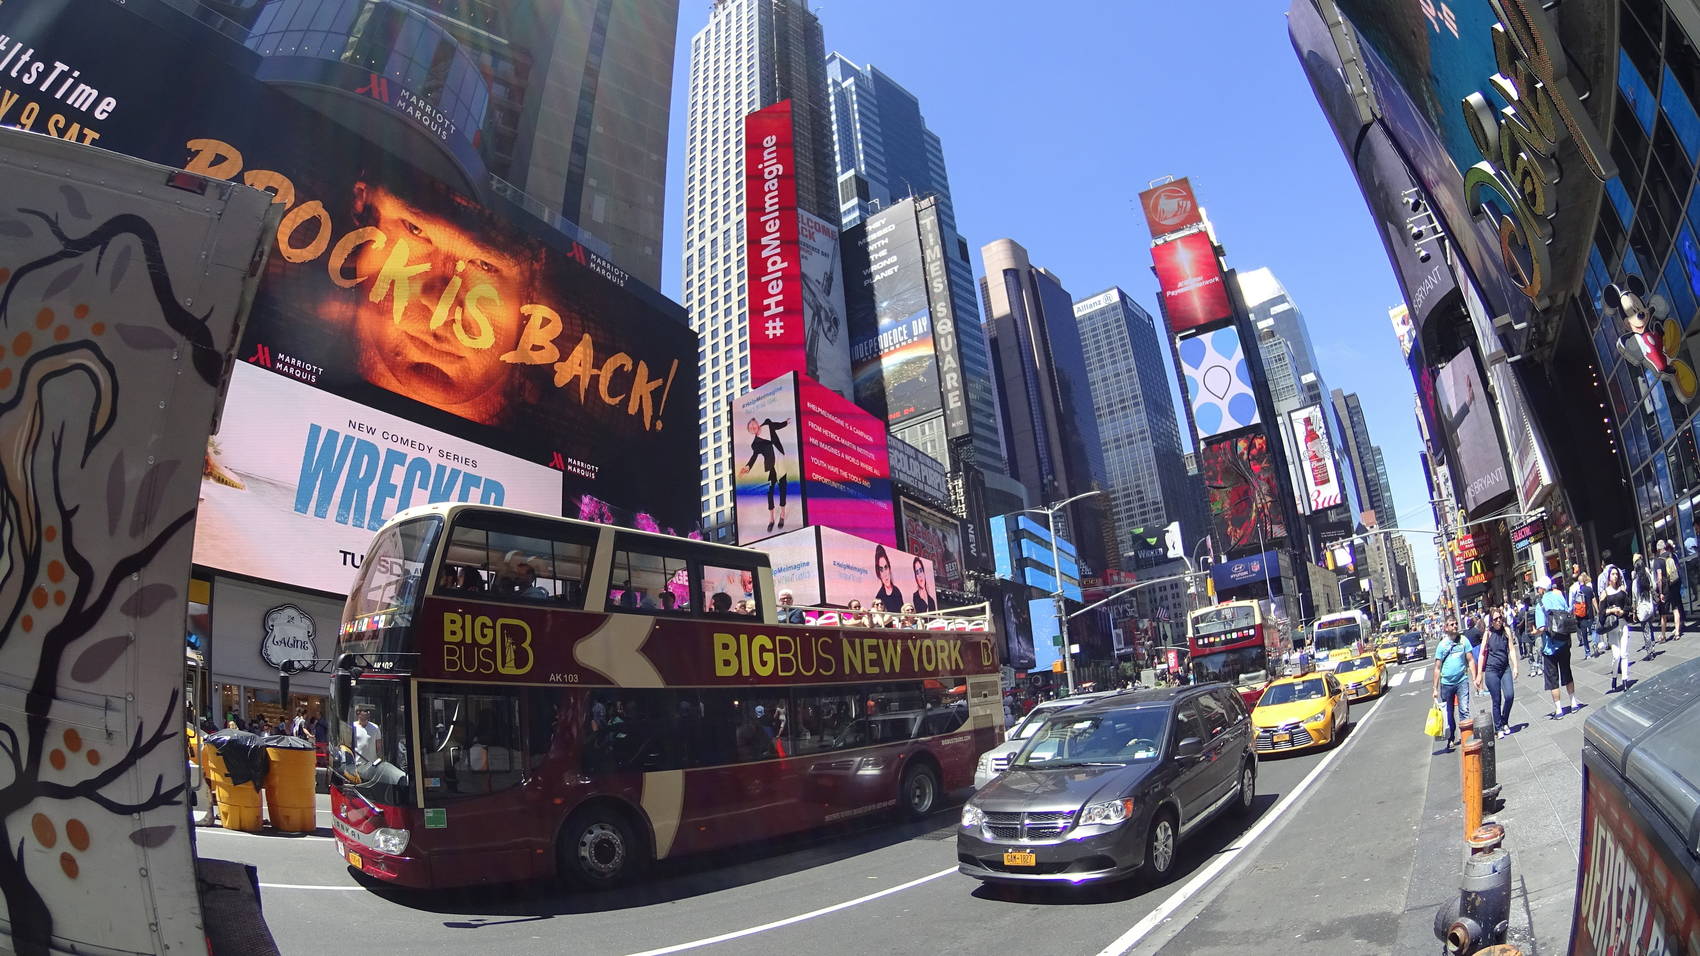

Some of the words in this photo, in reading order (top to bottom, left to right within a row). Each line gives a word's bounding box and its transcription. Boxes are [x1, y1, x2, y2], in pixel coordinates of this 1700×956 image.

[396, 100, 448, 140] MARQUIS
[400, 89, 456, 134] MARRIOTT
[590, 253, 630, 280] MARRIOTT
[862, 255, 898, 276] WRONG
[869, 249, 888, 261] THE
[589, 262, 625, 287] MARQUIS
[920, 216, 944, 293] TIMES
[936, 302, 962, 409] SQUARE
[1076, 300, 1102, 314] Allianz
[912, 316, 928, 336] DAY
[276, 363, 317, 383] MARQUIS
[277, 353, 324, 375] MARRIOTT
[500, 304, 679, 431] BACK!
[348, 419, 377, 437] NEW
[381, 430, 434, 455] COMEDY
[437, 448, 480, 469] SERIES
[567, 457, 599, 473] MARRIOTT
[567, 465, 596, 480] MARQUIS
[967, 523, 978, 557] NEW
[443, 612, 494, 646] BIG
[443, 645, 495, 675] BUS
[842, 637, 901, 674] NEW
[909, 639, 965, 671] YORK
[549, 673, 562, 683] AK
[563, 673, 579, 684] 103
